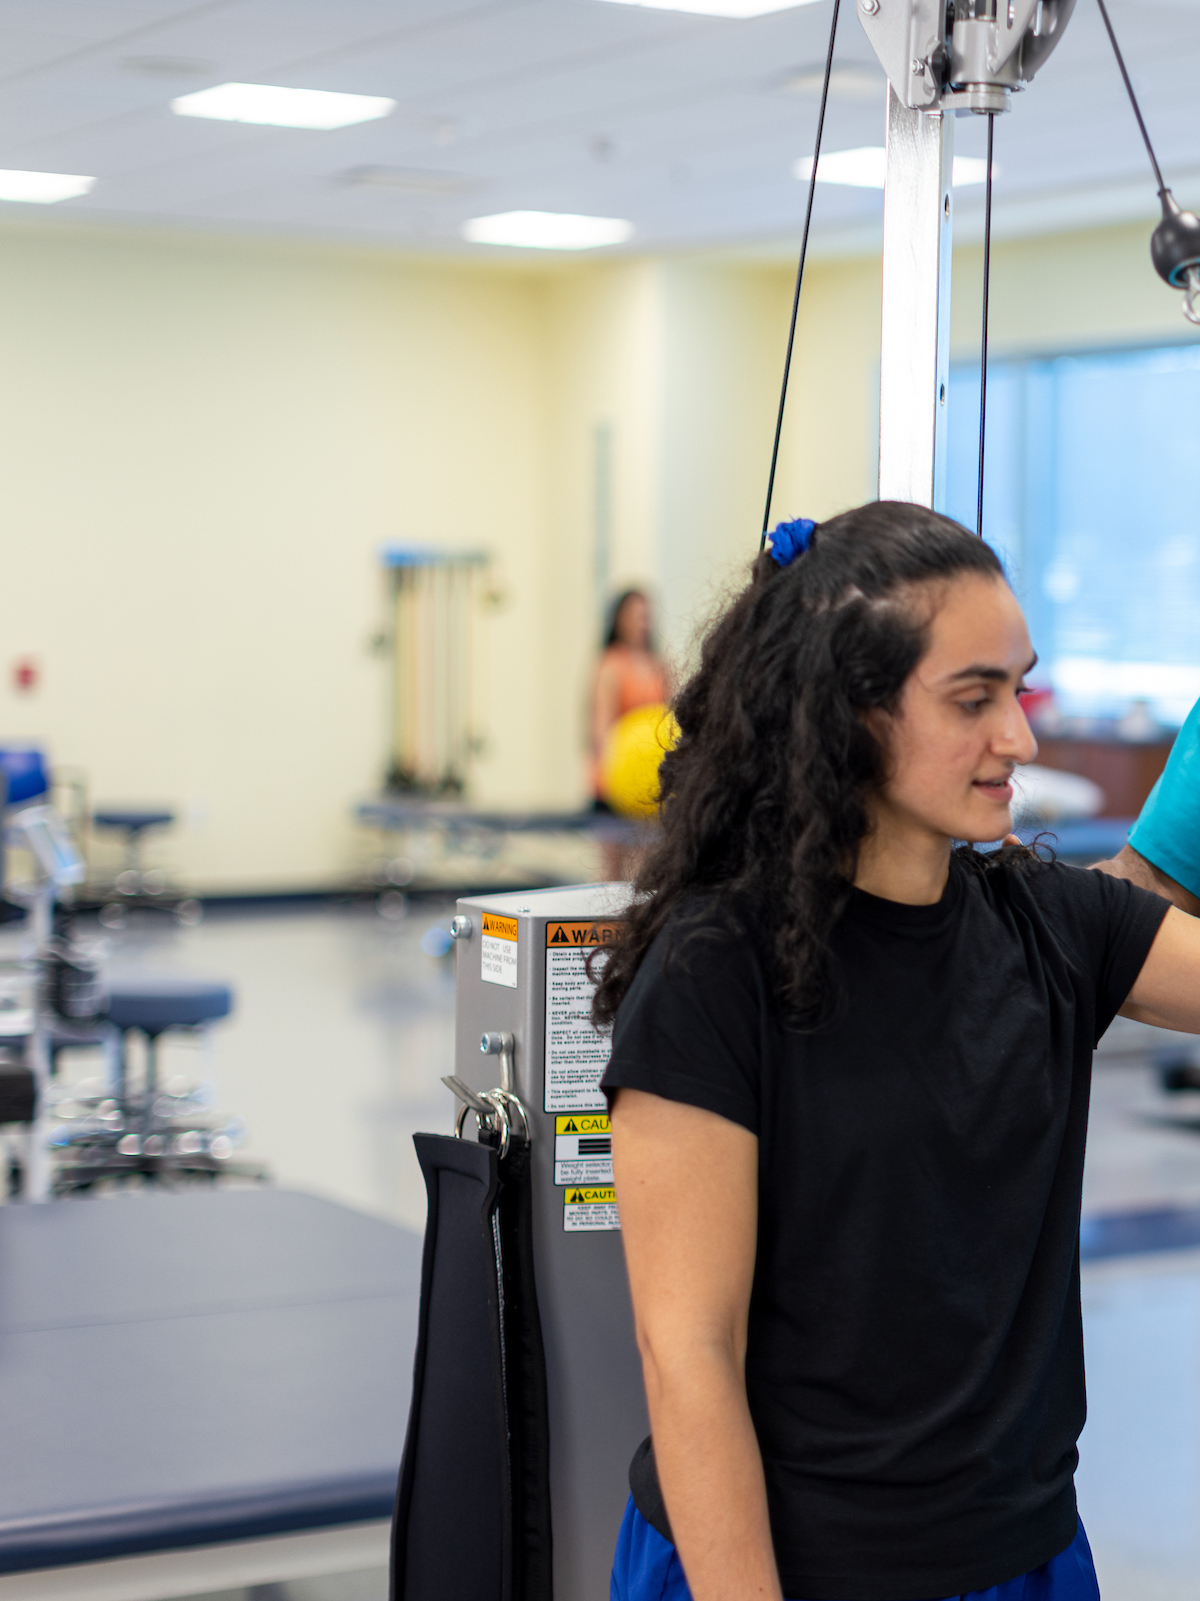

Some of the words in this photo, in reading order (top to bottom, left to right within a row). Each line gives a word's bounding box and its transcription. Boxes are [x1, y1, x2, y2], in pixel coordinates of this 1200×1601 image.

[490, 920, 516, 936] WARNING
[572, 929, 623, 943] WARN
[491, 942, 500, 951] NOT
[503, 945, 511, 954] USE
[483, 951, 502, 963] MACHINE
[504, 956, 516, 965] FROM
[483, 961, 492, 971] THIS
[493, 964, 502, 974] SIDE
[585, 1190, 616, 1199] CAUTI
